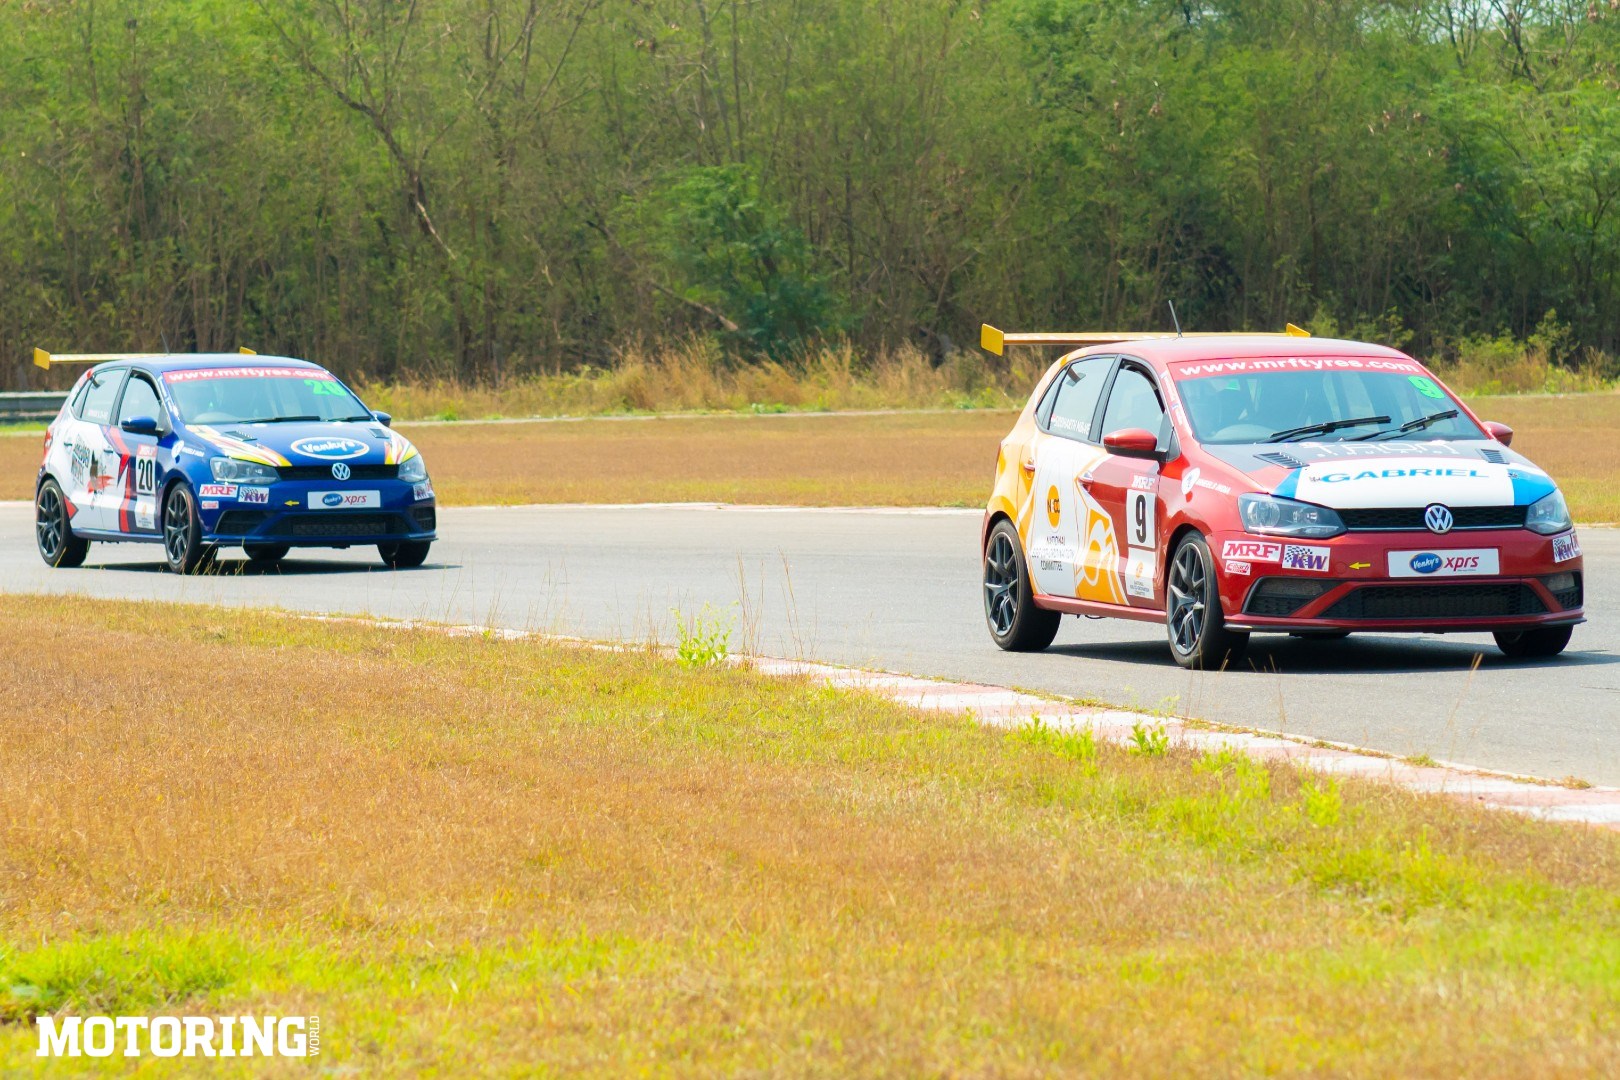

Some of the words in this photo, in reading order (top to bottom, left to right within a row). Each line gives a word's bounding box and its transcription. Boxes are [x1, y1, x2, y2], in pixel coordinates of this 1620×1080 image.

[1180, 358, 1419, 376] www.mrftyres.com
[304, 379, 347, 396] 20
[1408, 375, 1445, 399] 9
[302, 440, 356, 452] Venky's
[138, 459, 153, 491] 20
[1131, 474, 1155, 490] MRF
[1322, 468, 1490, 483] GABRIEL
[201, 486, 237, 496] MRF
[244, 492, 268, 503] KW
[344, 495, 367, 505] xprs
[1135, 494, 1147, 543] 9
[1224, 543, 1280, 559] MRF
[1290, 553, 1328, 570] KW
[1413, 557, 1440, 569] Venky's
[1443, 556, 1479, 571] xprs
